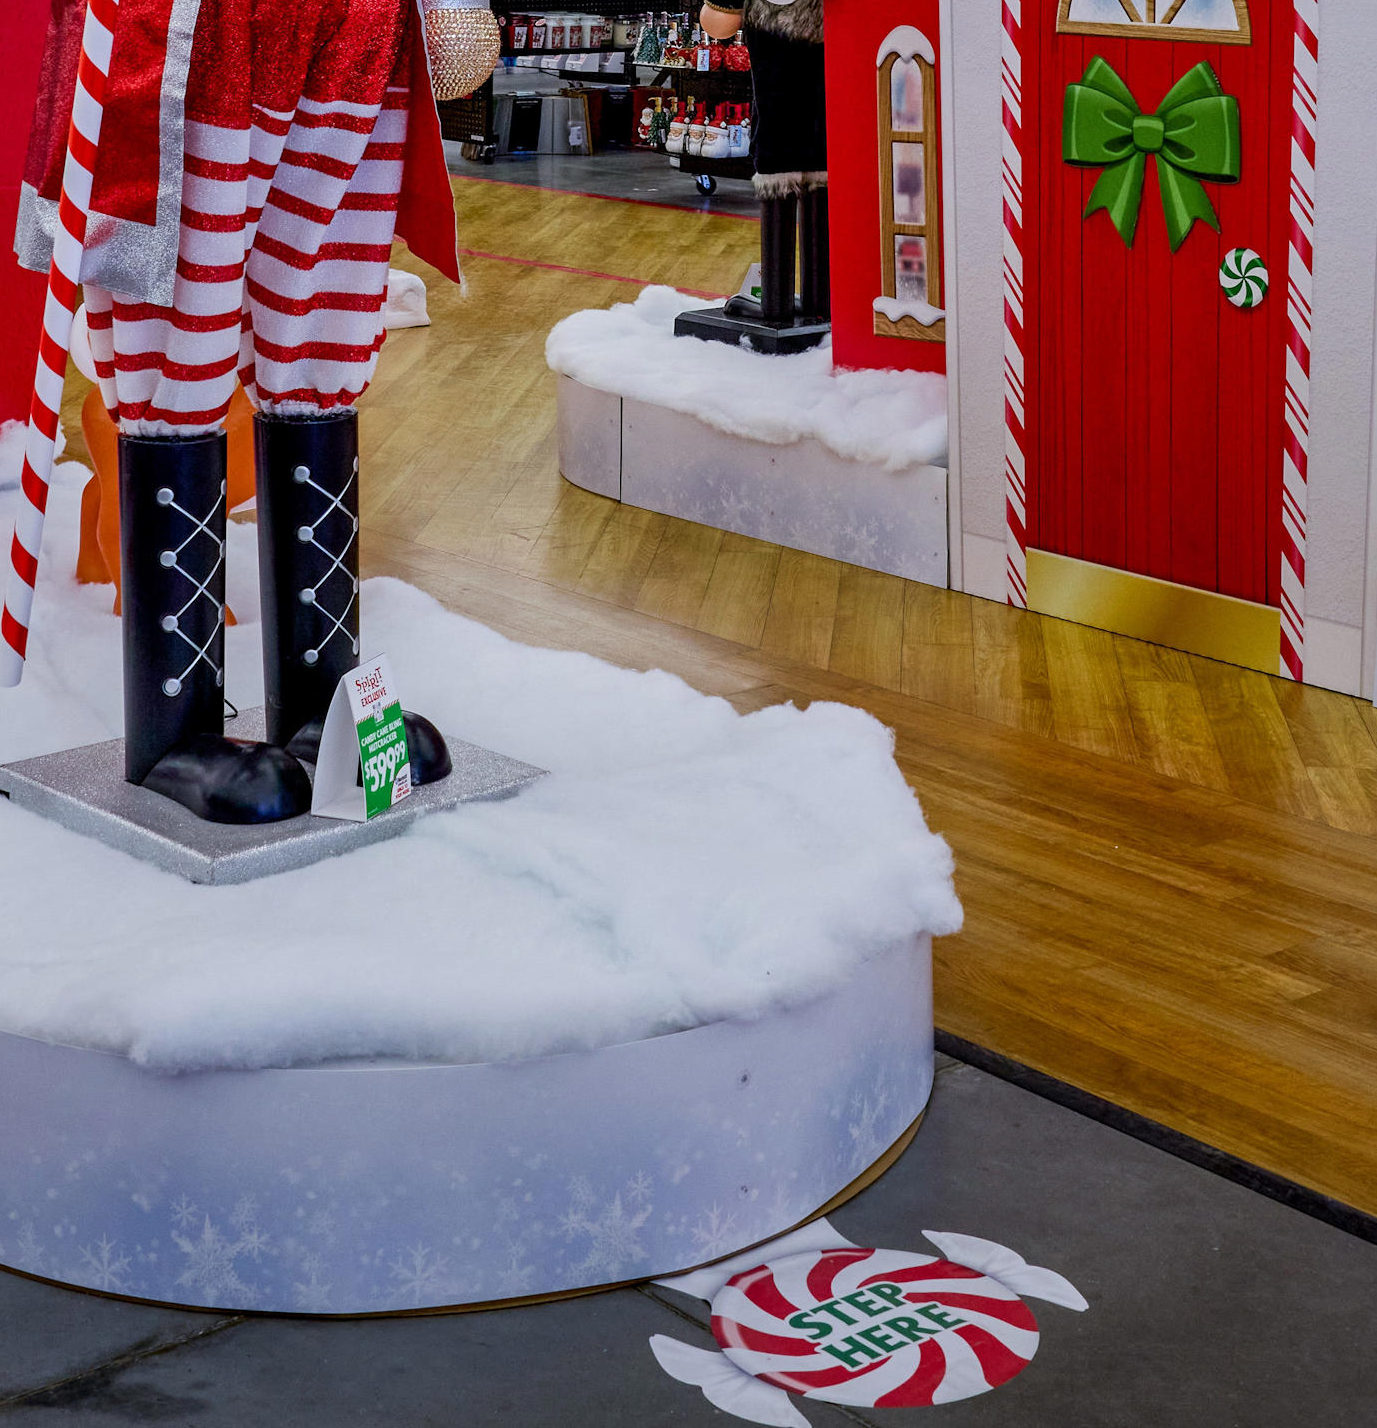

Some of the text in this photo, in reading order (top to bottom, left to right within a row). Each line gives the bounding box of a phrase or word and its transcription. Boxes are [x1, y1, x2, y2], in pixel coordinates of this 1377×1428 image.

[355, 666, 383, 695] SPIRIT
[360, 686, 387, 708] EXCLUSIVE
[361, 732, 377, 747] CANDY
[376, 725, 390, 739] CANE
[368, 731, 398, 754] NUTCRACKER
[788, 1283, 907, 1340] STEP
[821, 1303, 968, 1368] HERE
